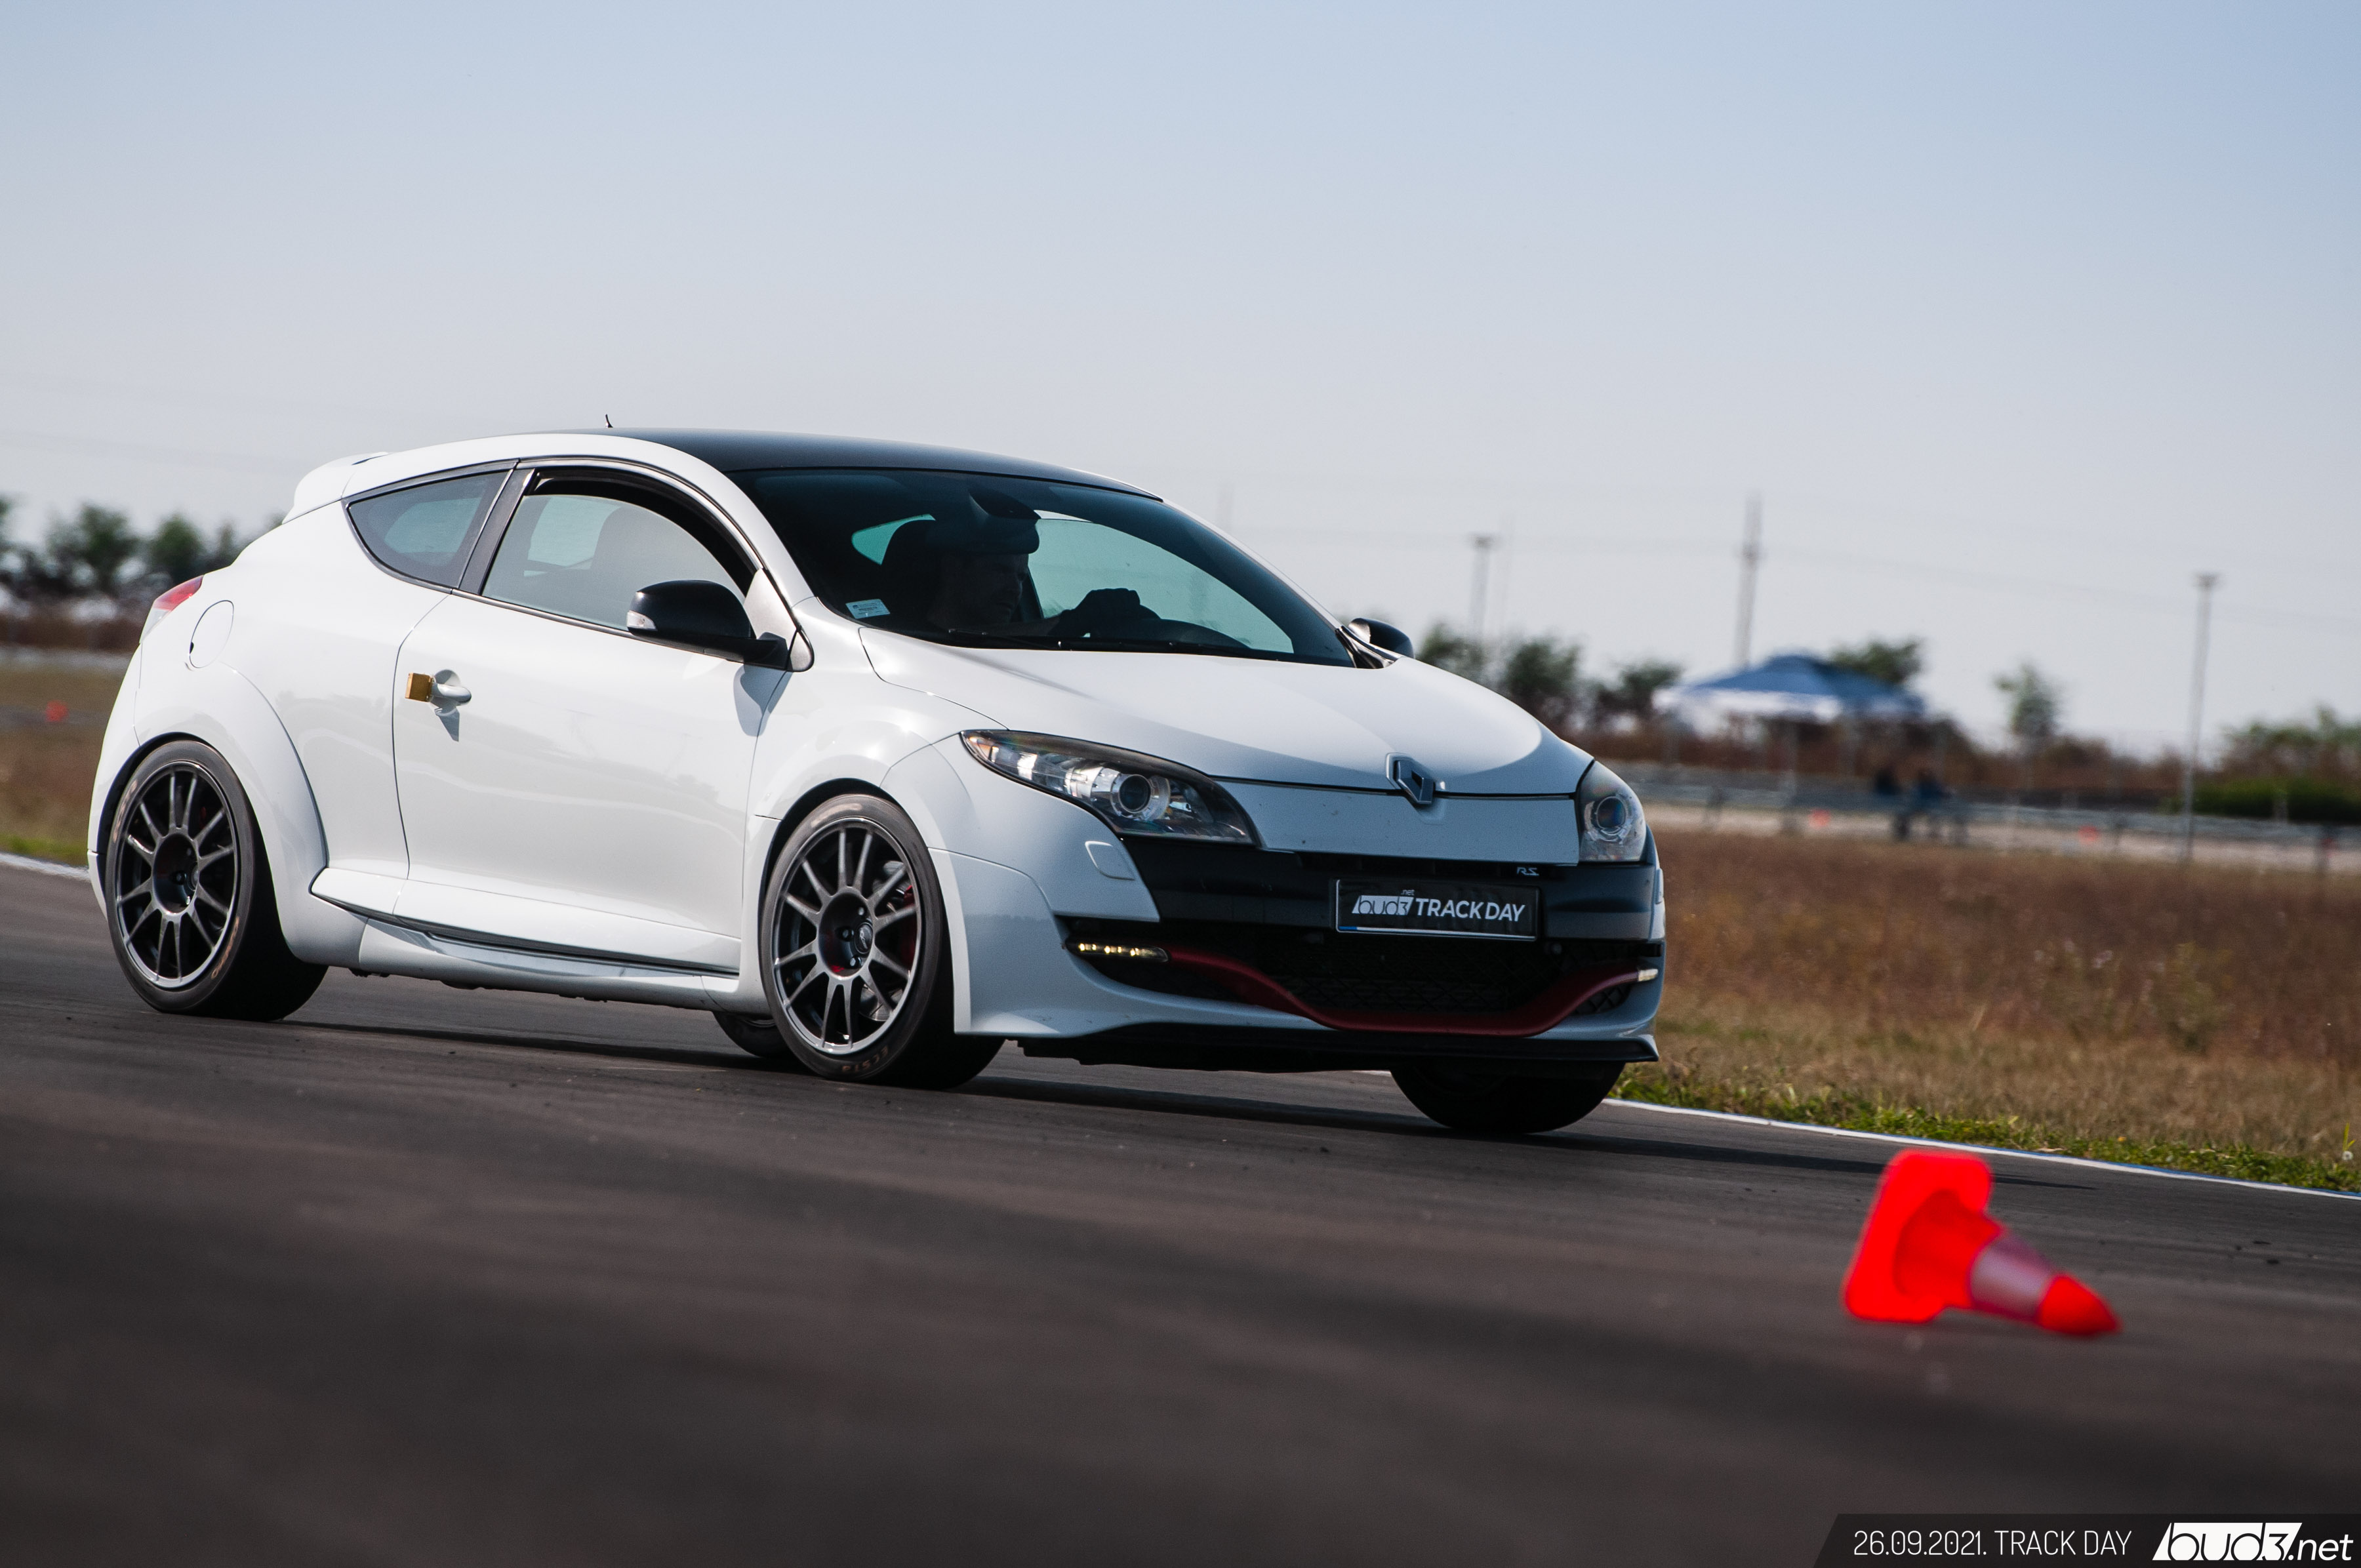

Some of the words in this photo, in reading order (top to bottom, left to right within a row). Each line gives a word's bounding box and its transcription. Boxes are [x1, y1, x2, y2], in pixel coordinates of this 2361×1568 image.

[1517, 867, 1539, 875] RS
[1416, 898, 1484, 919] TRACK
[1485, 902, 1525, 922] DAY
